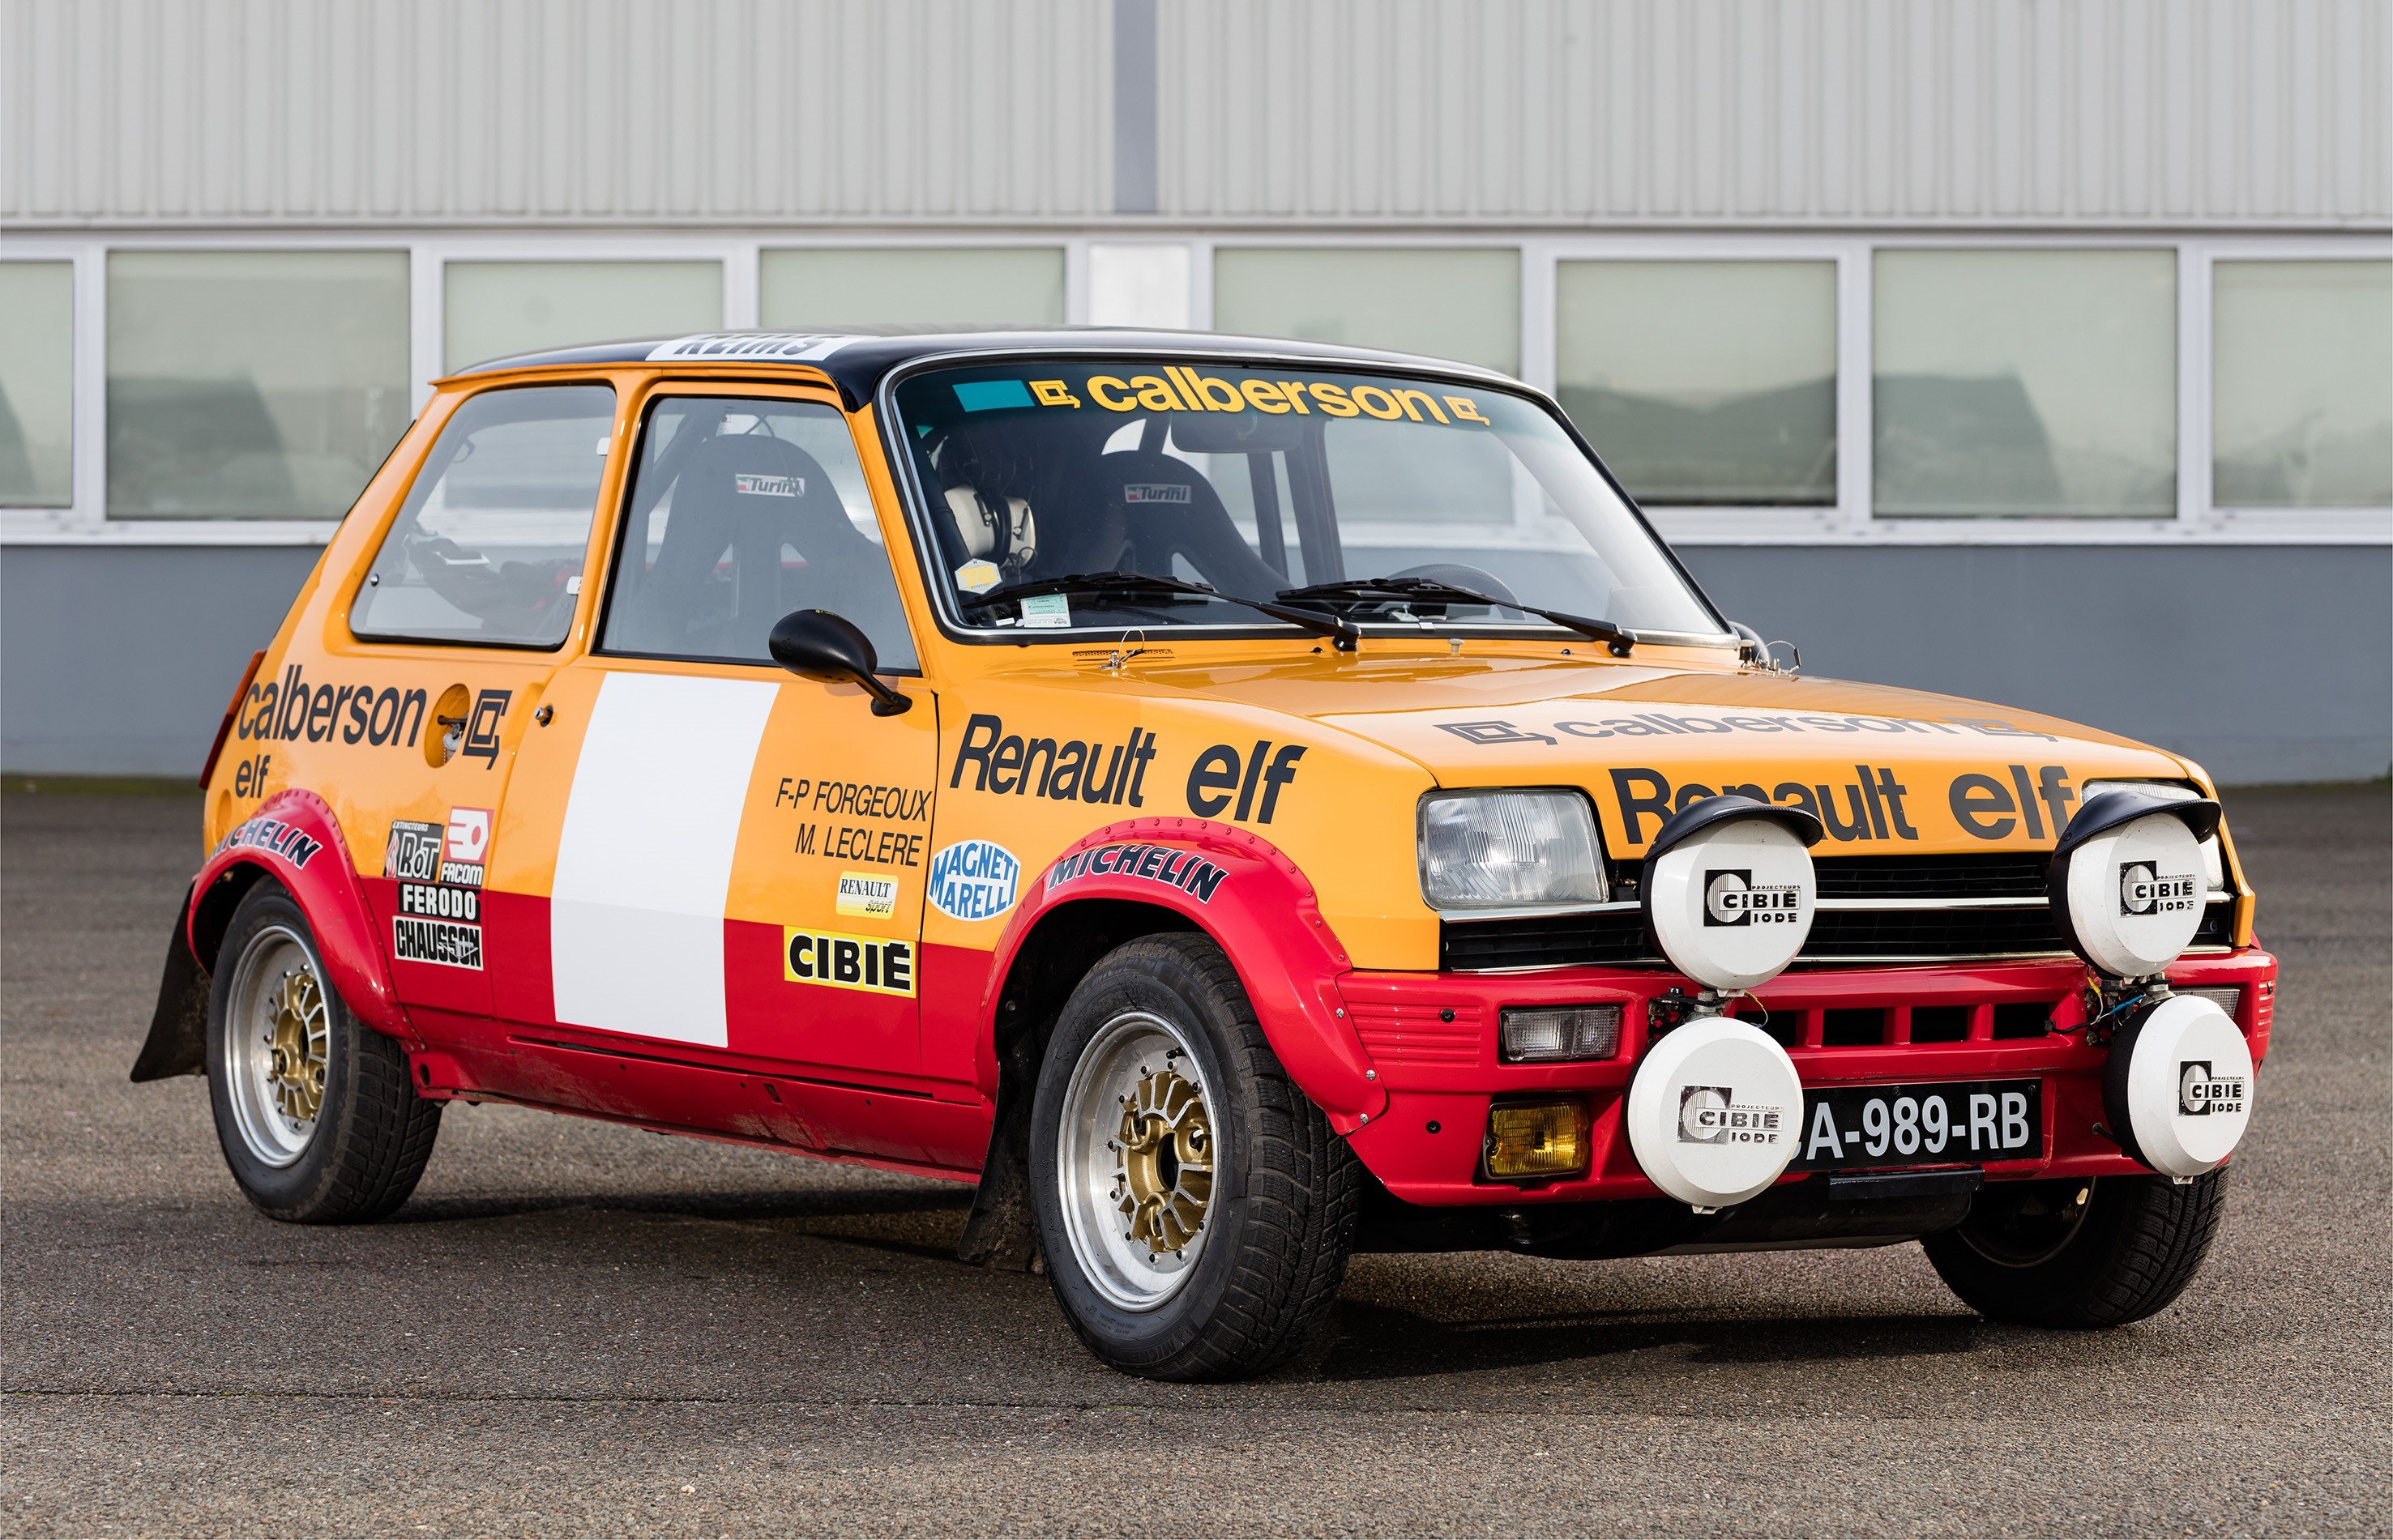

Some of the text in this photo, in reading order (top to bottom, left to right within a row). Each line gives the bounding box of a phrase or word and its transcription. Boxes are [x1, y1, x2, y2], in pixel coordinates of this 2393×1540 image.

[1087, 366, 1451, 424] calberson
[238, 664, 426, 747] calberson
[1553, 714, 1960, 738] calberson
[235, 755, 271, 798] elf
[950, 714, 1308, 825] Renault elf
[776, 778, 932, 821] F-P FORGEOUX
[1608, 765, 2074, 842] Rault elf
[795, 823, 923, 867] M. LECLERE
[932, 843, 1019, 881] MAGNETI
[440, 862, 484, 886] FACOM
[840, 878, 891, 898] RENAULT
[1046, 843, 1229, 905] MICHELIN
[403, 884, 476, 920] FERODO
[865, 899, 892, 914] sport
[929, 875, 1015, 919] MARELLI
[1754, 912, 1797, 923] IODE
[395, 919, 481, 967] CHAUSSON
[1791, 1092, 2029, 1160] A-989-RB
[2212, 1103, 2241, 1113] IODE
[1731, 1132, 1779, 1144] IODE
